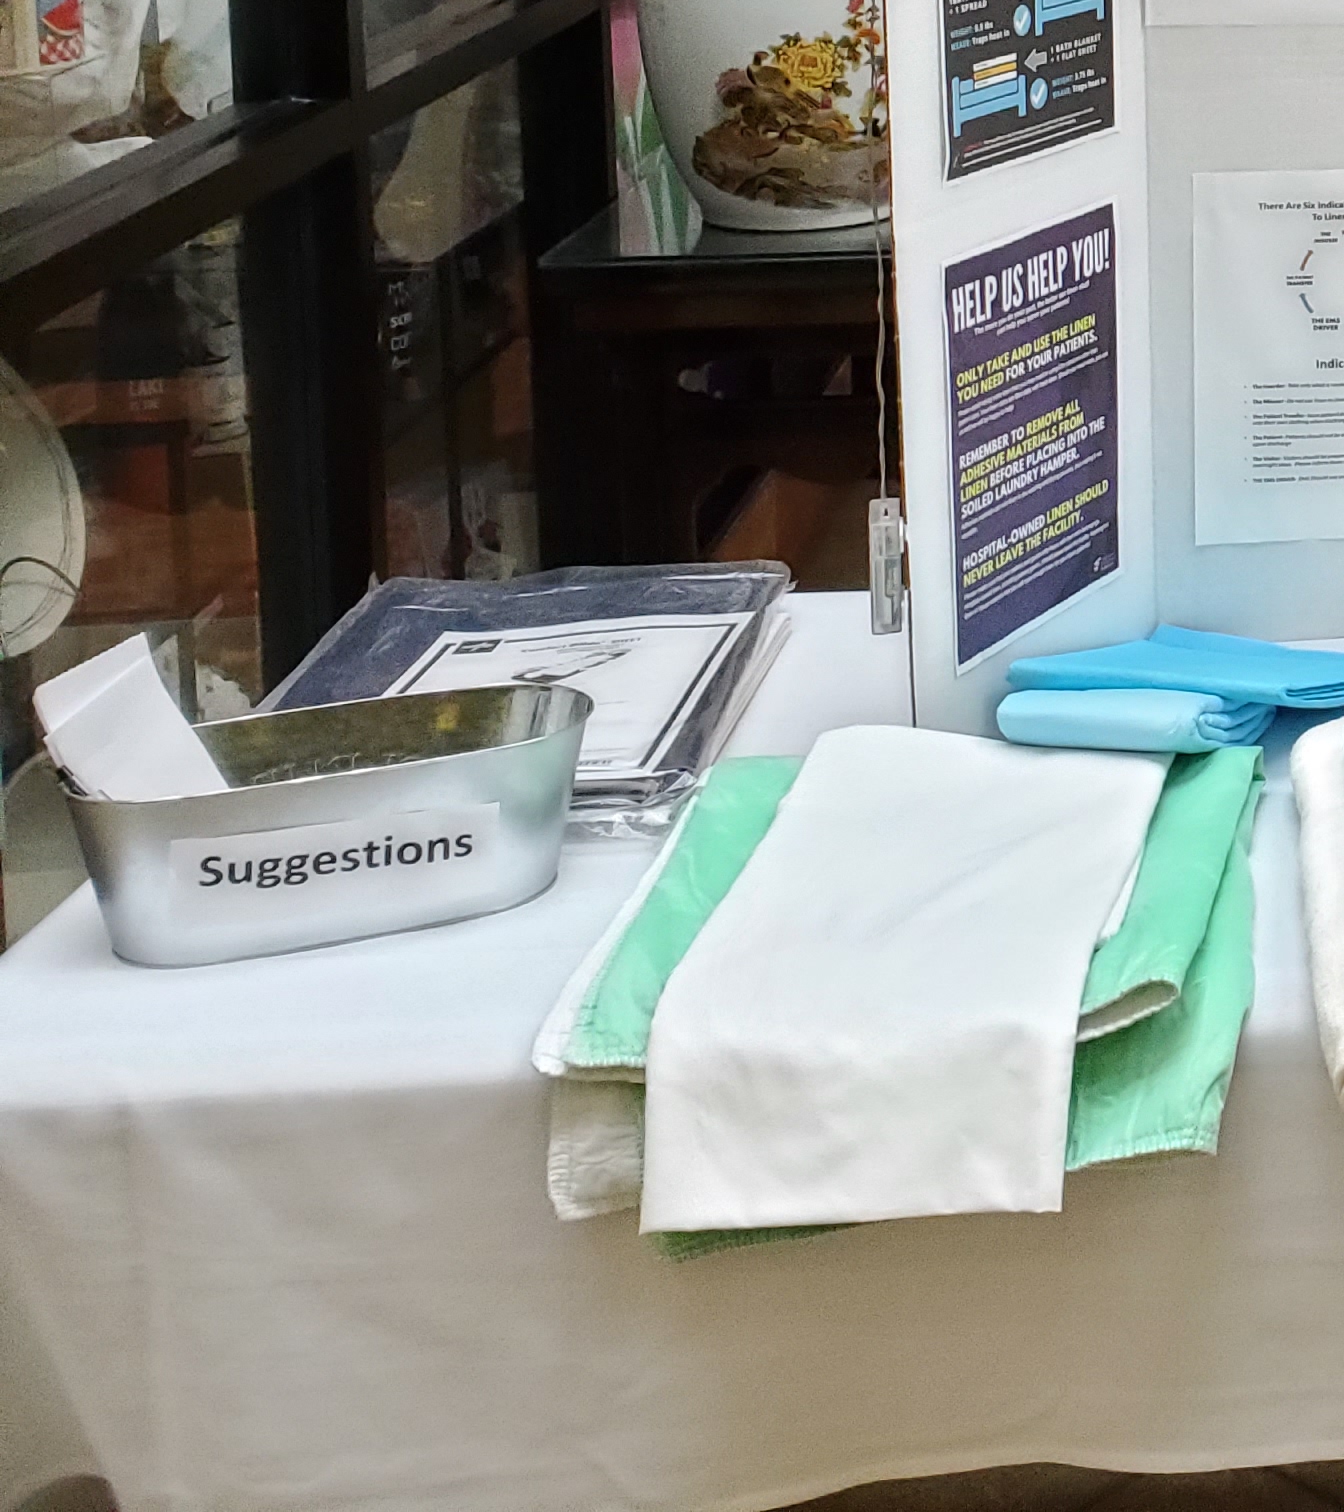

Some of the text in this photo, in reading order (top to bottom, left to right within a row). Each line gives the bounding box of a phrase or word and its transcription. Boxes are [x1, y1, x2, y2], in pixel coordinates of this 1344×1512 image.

[952, 227, 1110, 334] HELP US HELP YOU!
[956, 313, 1096, 388] ONLY TAKE AND USE THE LINEN
[956, 328, 1098, 404] YOU NEED FOR YOUR PATIENTS.
[962, 478, 1110, 572] HOSPITAL-OWNED LINEN SHOULD
[962, 510, 1085, 588] NEVER LEAVE THE FACILITY.
[198, 832, 474, 889] Suggestions
